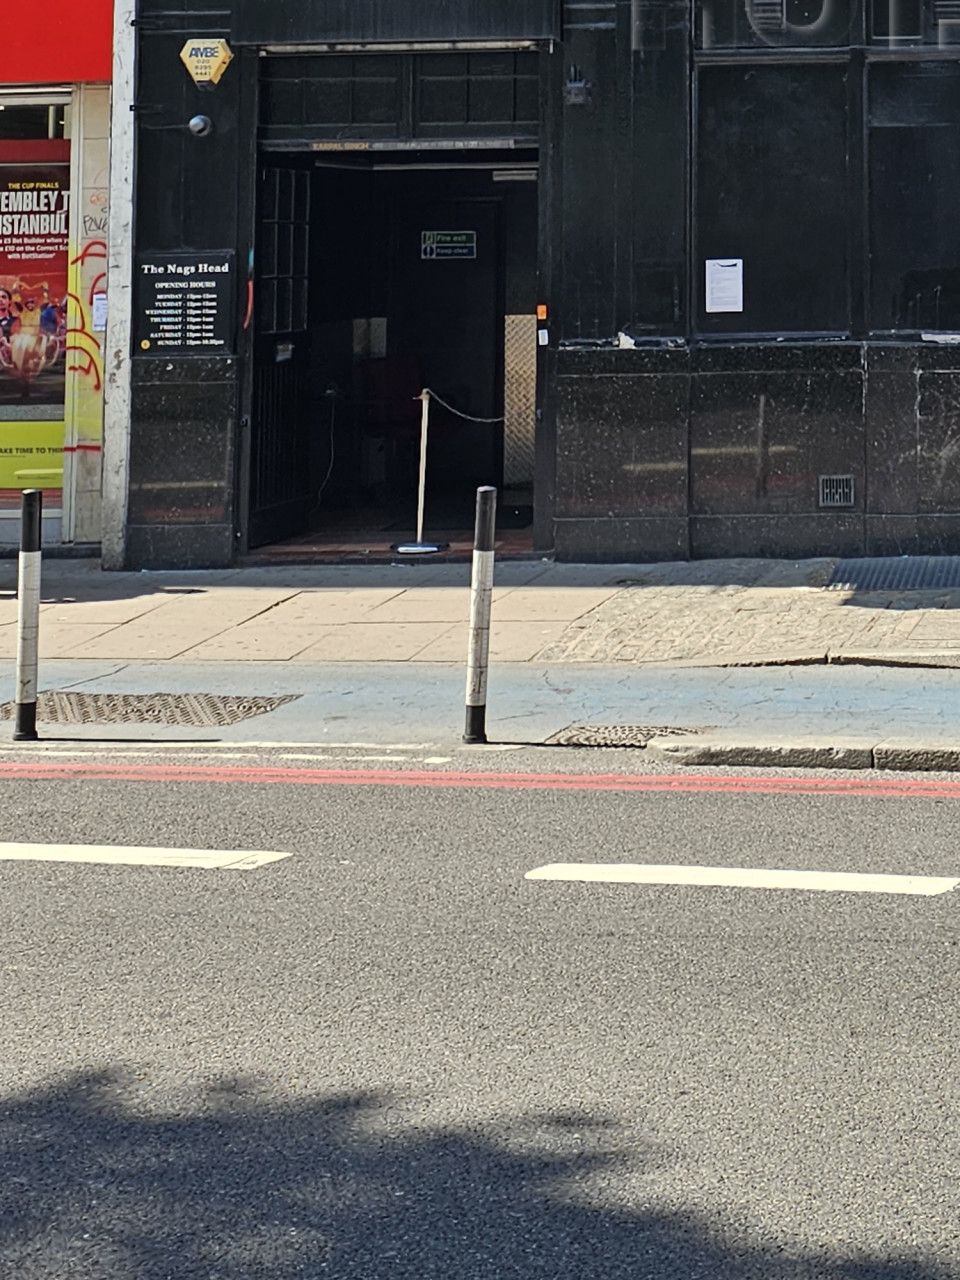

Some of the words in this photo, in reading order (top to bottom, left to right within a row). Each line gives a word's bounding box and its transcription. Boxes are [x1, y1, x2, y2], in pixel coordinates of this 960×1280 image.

[141, 264, 165, 274] The
[167, 263, 196, 276] Nags
[198, 263, 229, 273] Head
[154, 281, 188, 289] OPENING
